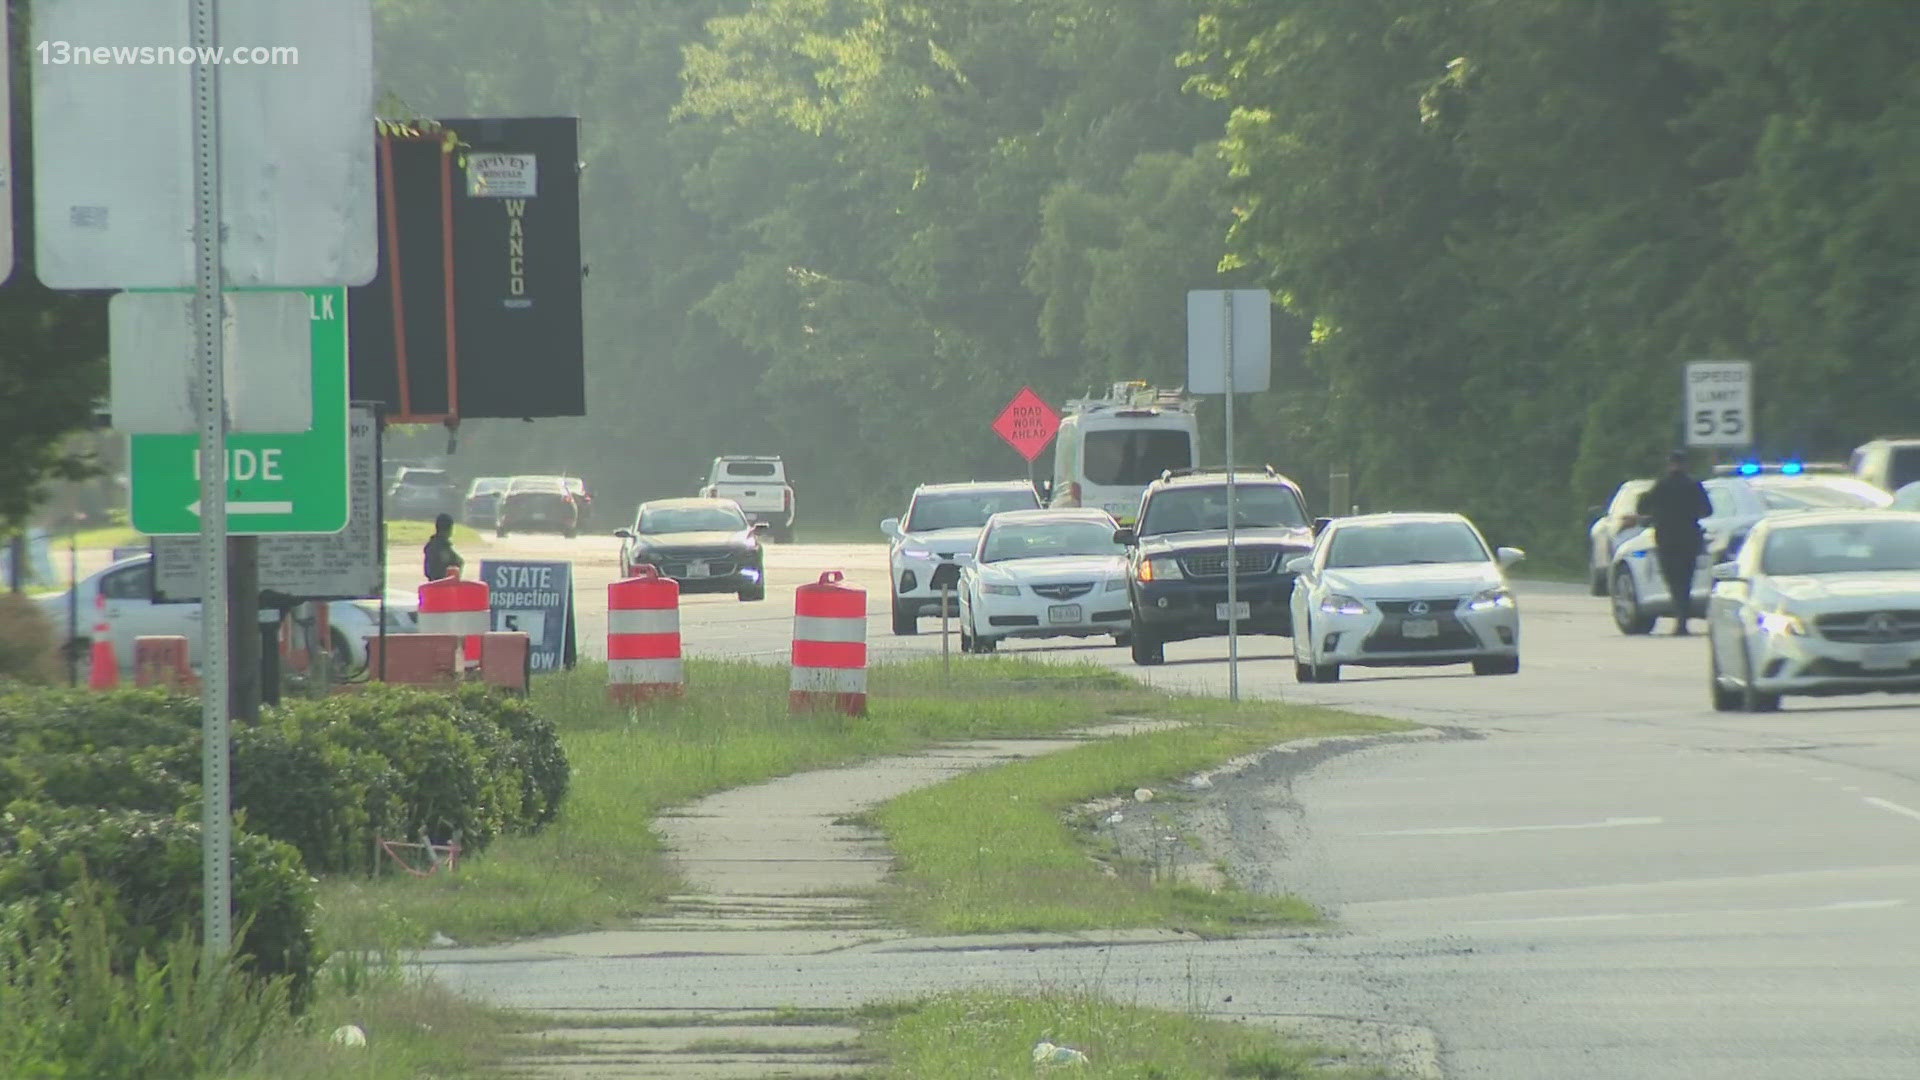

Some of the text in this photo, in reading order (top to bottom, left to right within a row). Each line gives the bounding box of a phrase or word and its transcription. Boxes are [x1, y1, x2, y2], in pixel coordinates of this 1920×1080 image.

[505, 199, 526, 295] WANCO
[309, 295, 335, 321] LK
[1690, 370, 1744, 384] SPEED
[1695, 390, 1741, 403] LIMIT
[1013, 406, 1042, 417] ROAD
[1014, 417, 1043, 429] WORK
[1694, 409, 1743, 436] 55
[1012, 429, 1047, 440] AHEAD
[496, 566, 552, 588] STATE
[490, 589, 560, 608] nspection
[530, 651, 556, 670] OW
